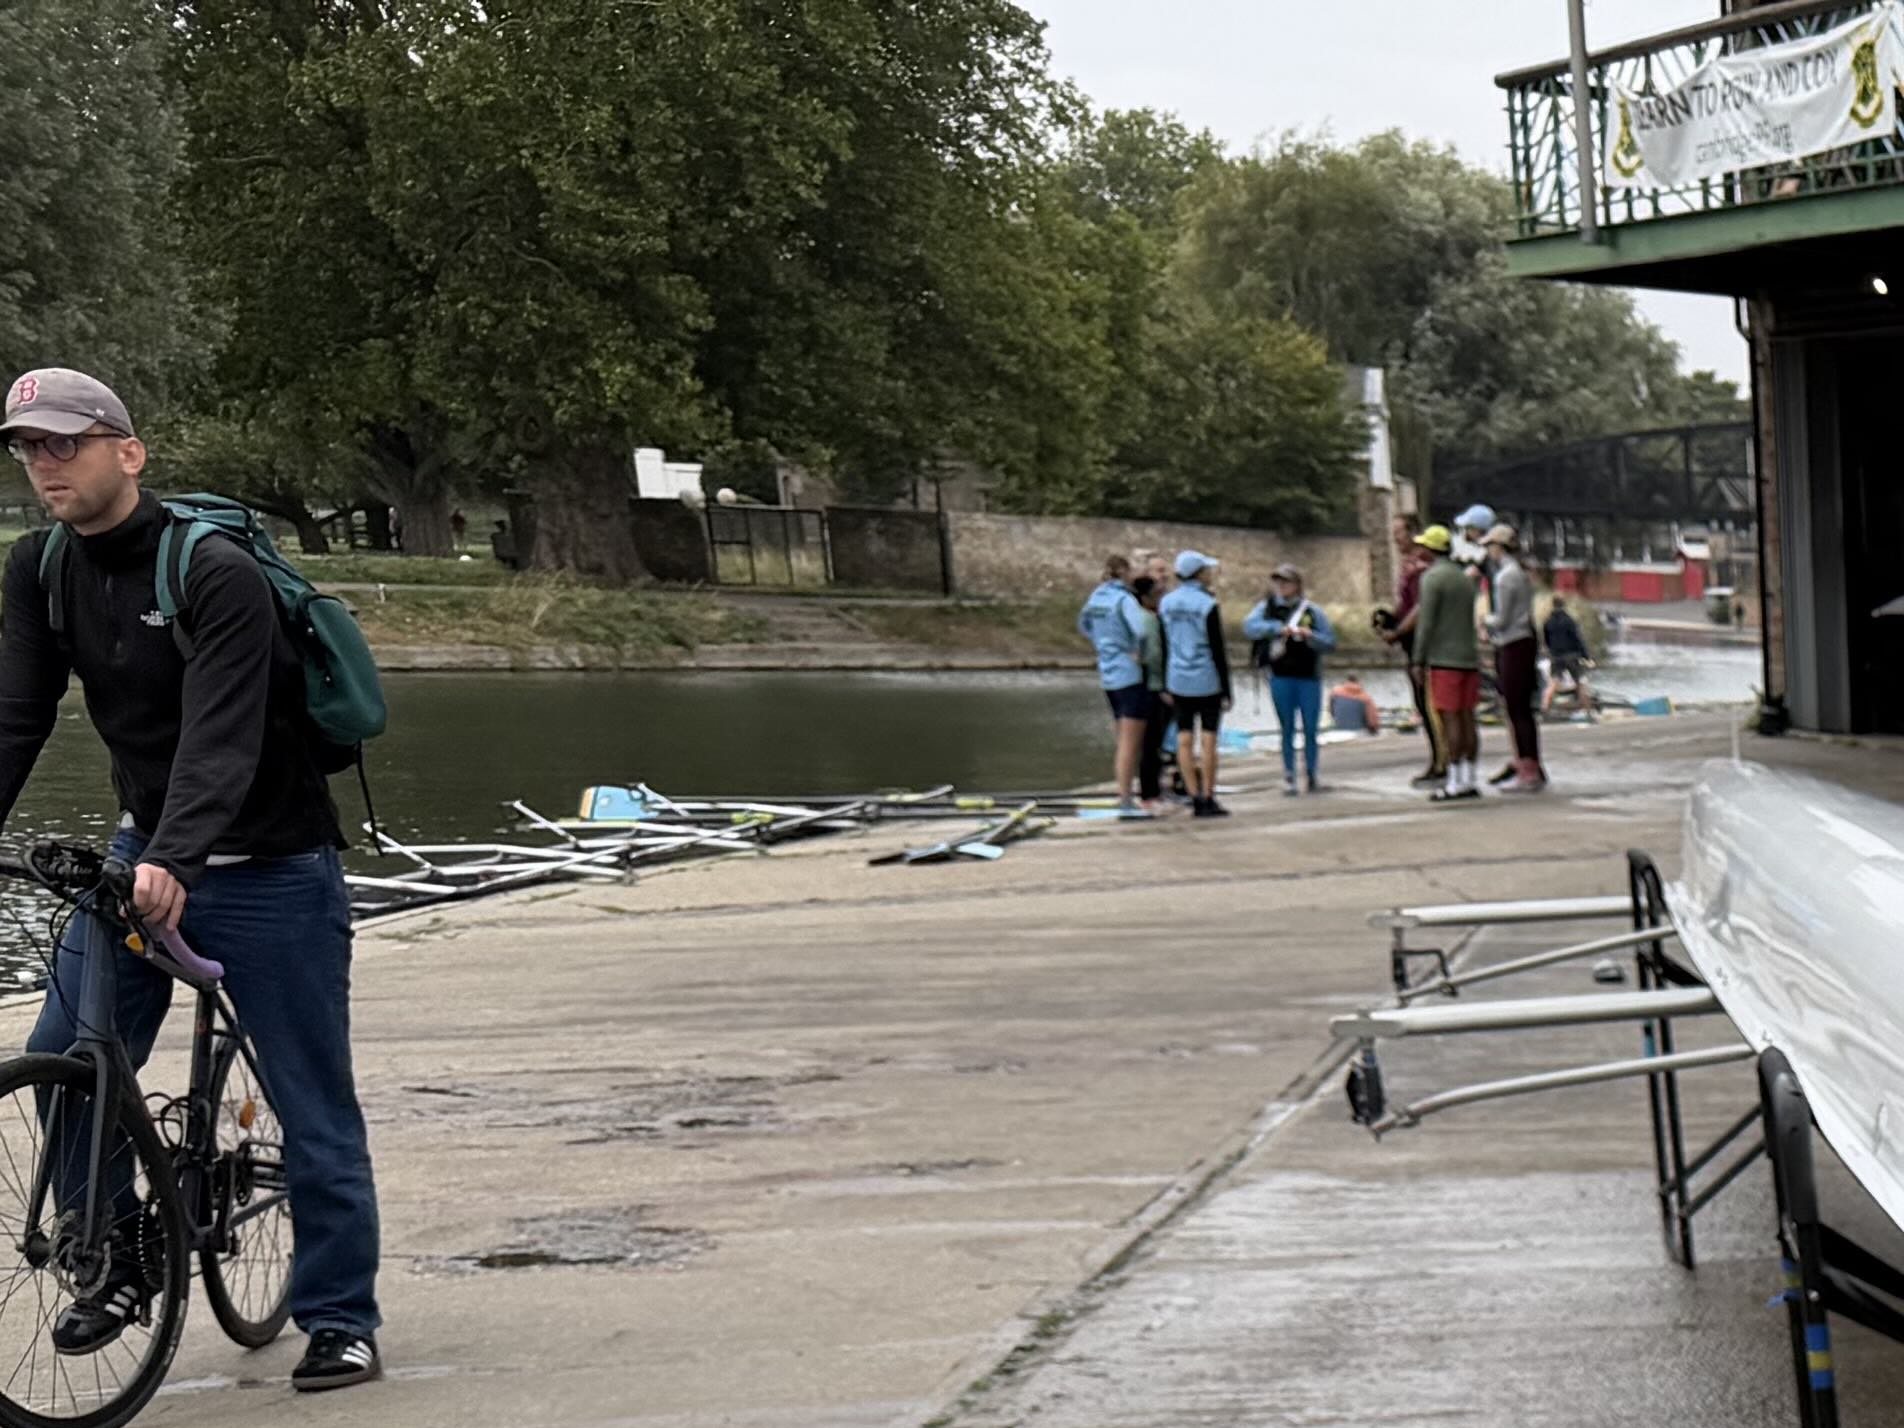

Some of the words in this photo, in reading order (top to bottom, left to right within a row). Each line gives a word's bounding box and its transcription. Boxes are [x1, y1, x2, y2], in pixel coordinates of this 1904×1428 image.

[1638, 87, 1693, 130] EARN
[1691, 81, 1718, 119] TO
[18, 377, 39, 405] B
